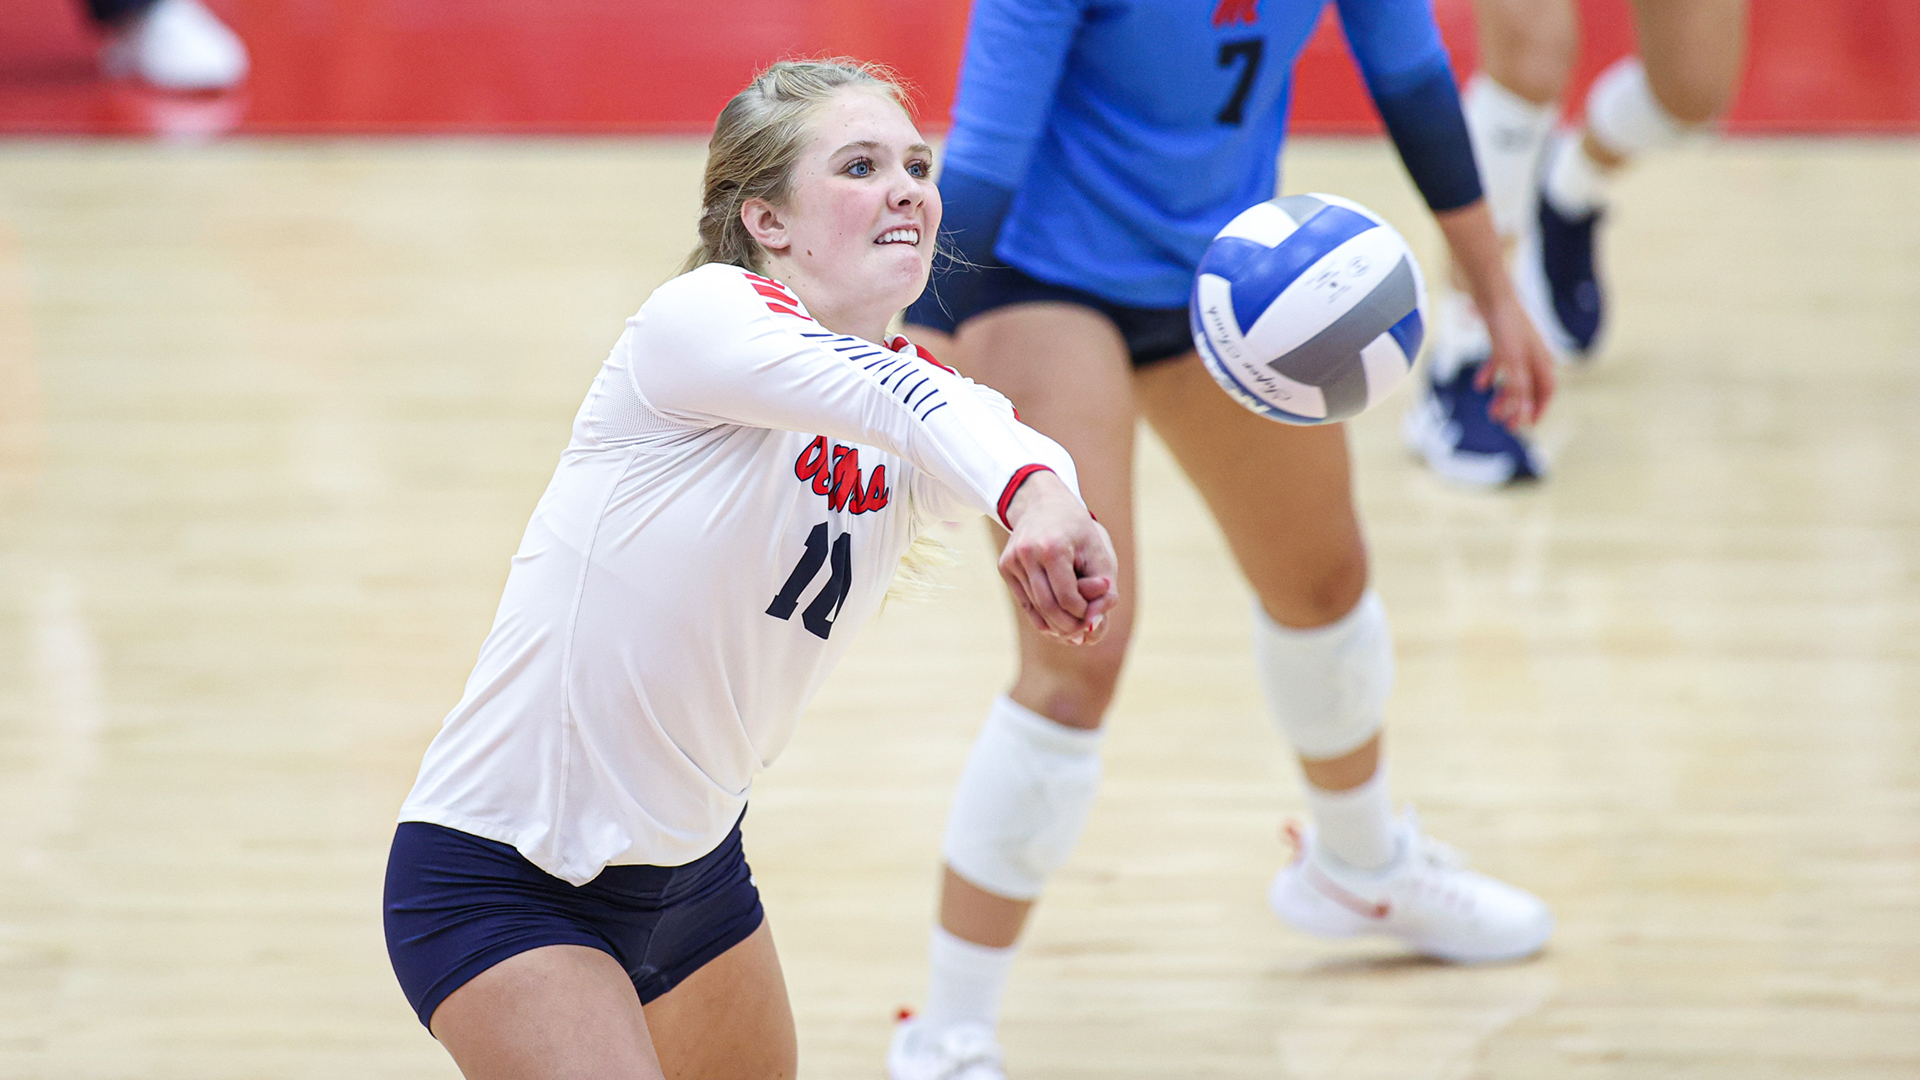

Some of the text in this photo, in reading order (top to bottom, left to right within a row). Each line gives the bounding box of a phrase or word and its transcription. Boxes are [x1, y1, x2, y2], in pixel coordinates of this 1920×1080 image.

[1216, 37, 1264, 125] 7
[1242, 362, 1293, 402] Super
[765, 521, 852, 640] 10
